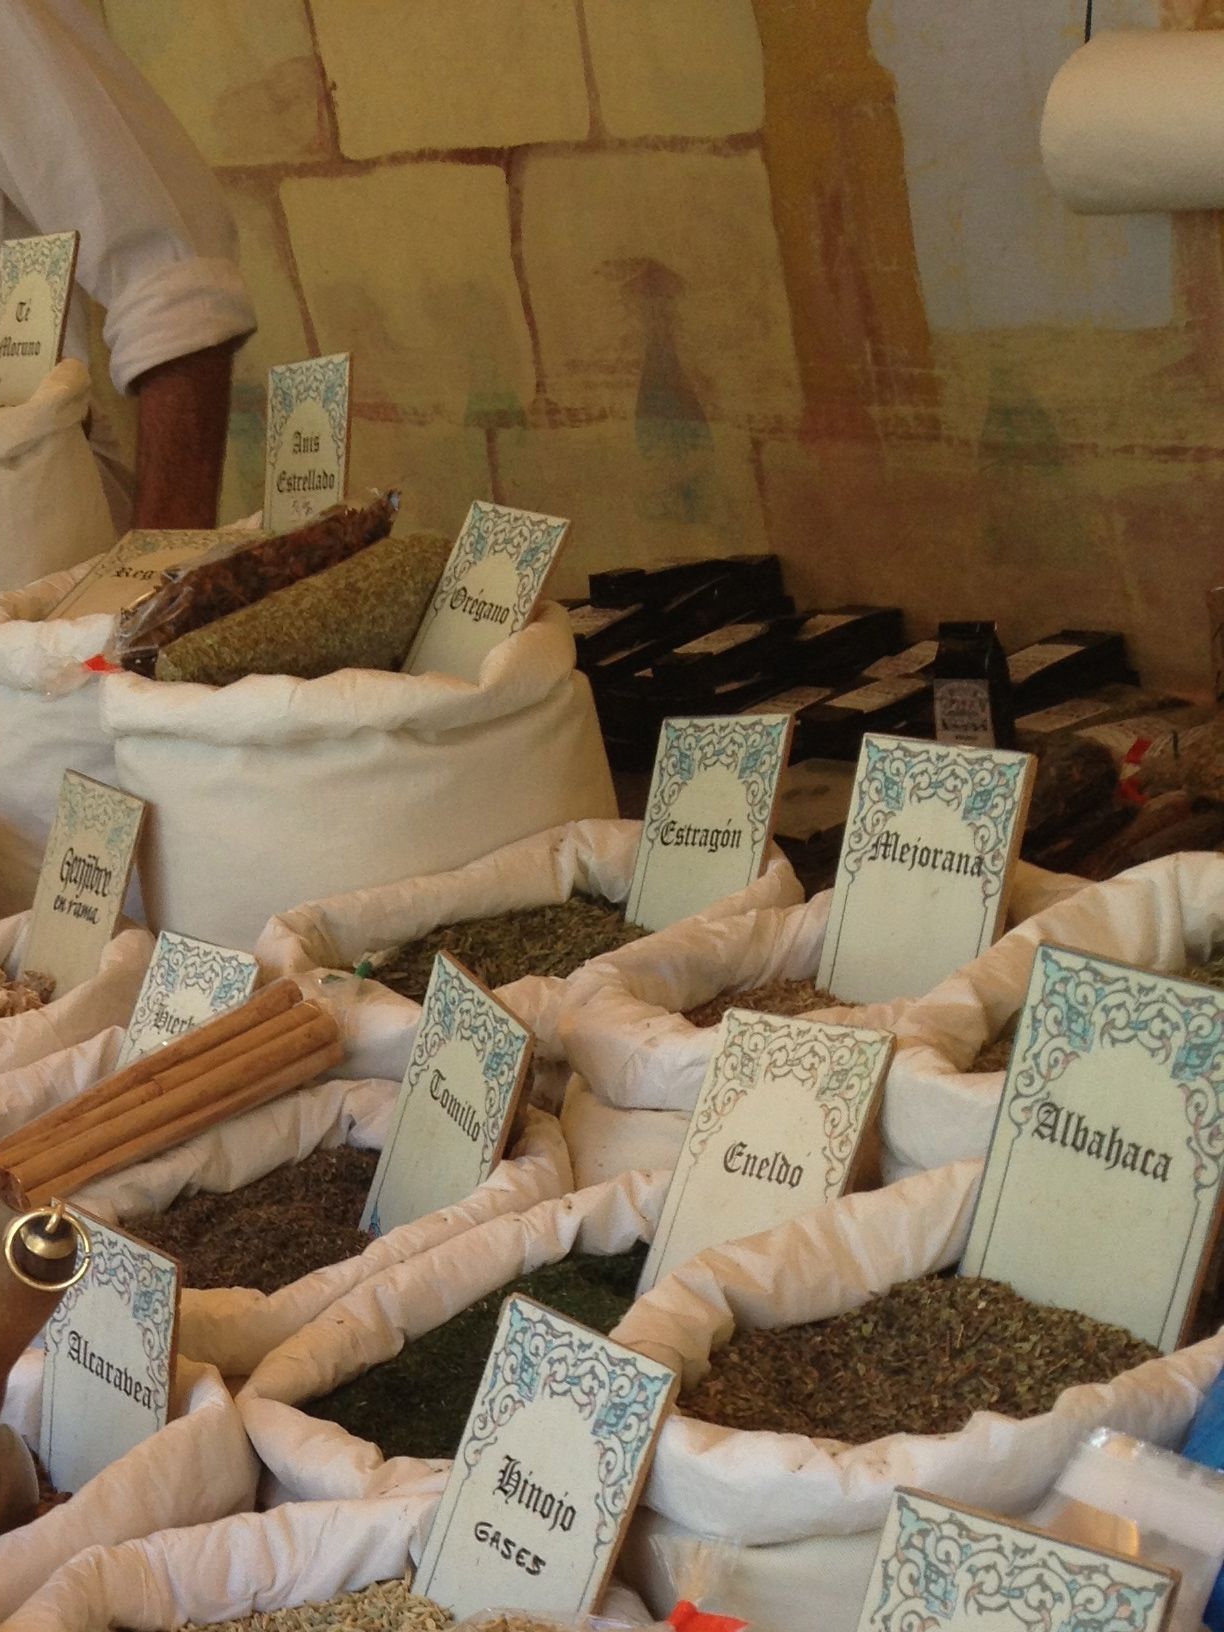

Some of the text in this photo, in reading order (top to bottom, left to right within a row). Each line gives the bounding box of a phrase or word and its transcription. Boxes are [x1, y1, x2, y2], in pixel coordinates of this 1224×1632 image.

[16, 298, 31, 323] Té
[276, 470, 335, 493] Estrellado
[449, 586, 510, 625] Orégano
[660, 818, 742, 854] Estragón
[867, 829, 985, 878] Mejorana
[429, 1068, 482, 1142] Tomillo
[1032, 1100, 1173, 1183] Albahaca
[492, 1454, 577, 1532] Hinojo
[474, 1521, 547, 1577] GASES
